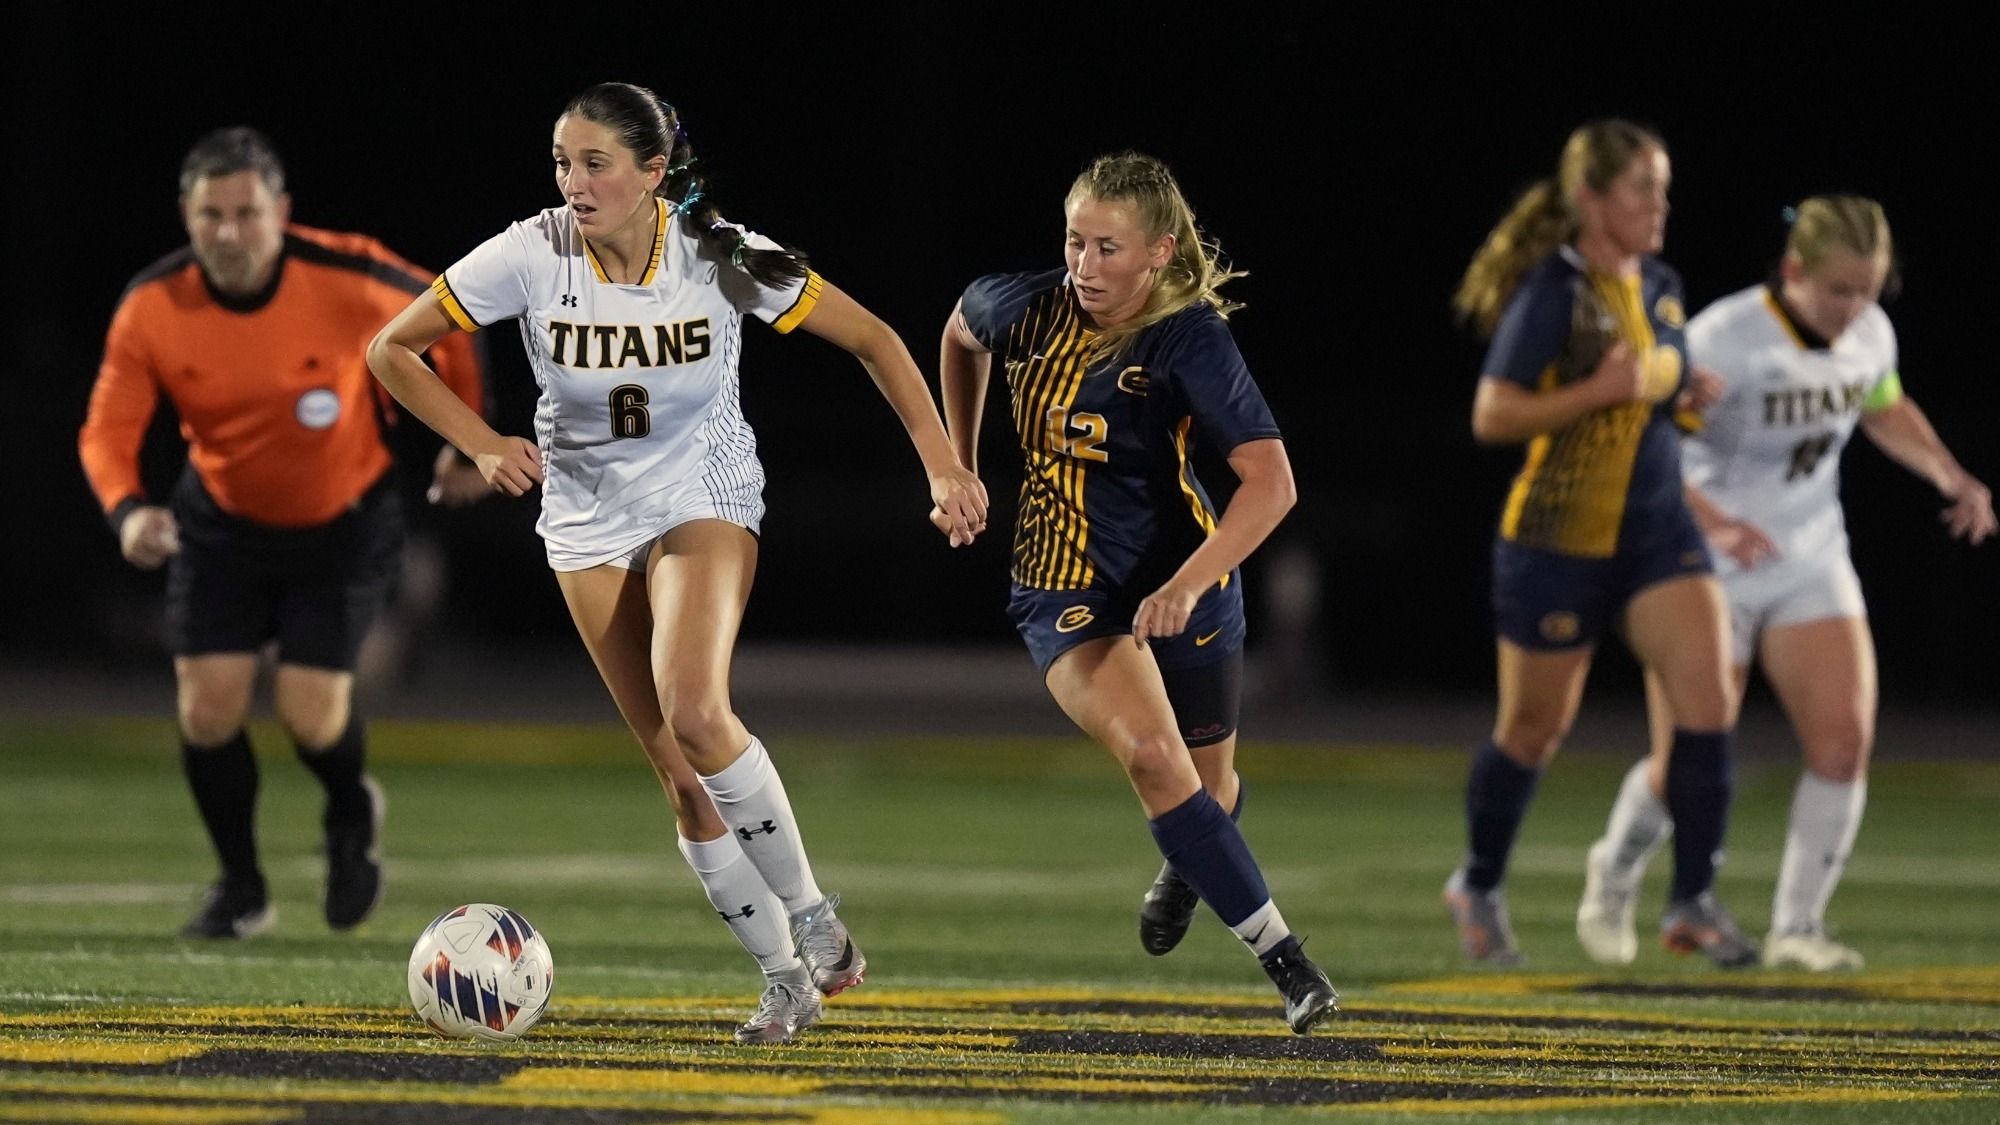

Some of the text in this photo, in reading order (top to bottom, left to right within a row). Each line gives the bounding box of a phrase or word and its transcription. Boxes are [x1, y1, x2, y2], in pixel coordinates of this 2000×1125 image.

[549, 318, 711, 369] TITANS
[608, 384, 651, 439] 6
[1046, 404, 1109, 463] 12
